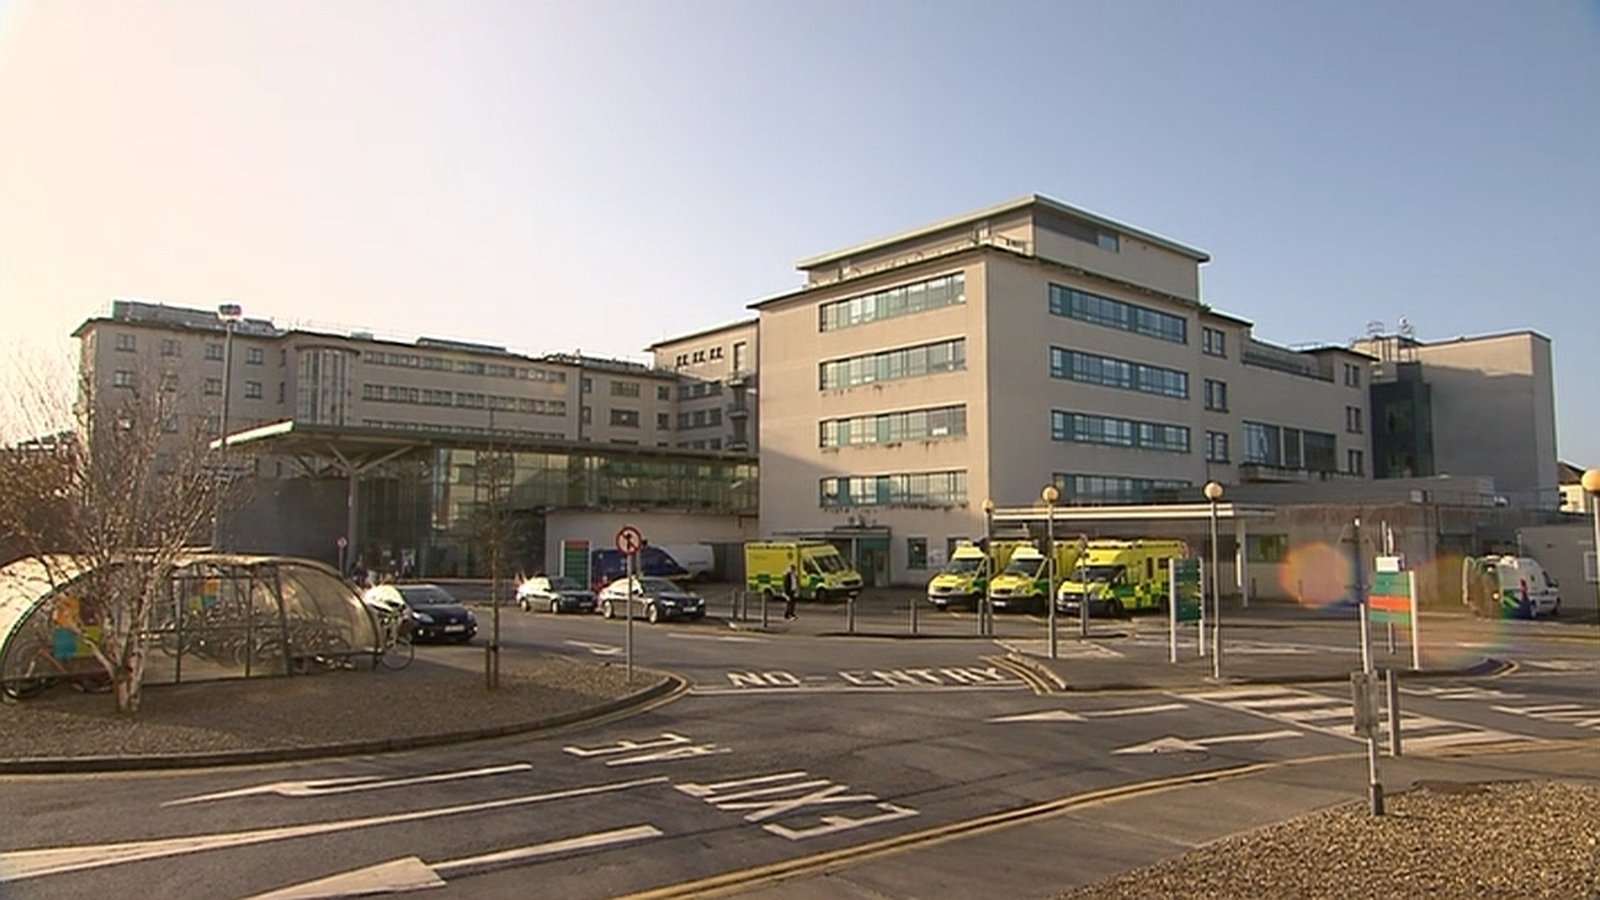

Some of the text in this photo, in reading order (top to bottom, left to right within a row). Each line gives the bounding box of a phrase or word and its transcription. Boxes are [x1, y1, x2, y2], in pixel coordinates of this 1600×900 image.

[726, 666, 1007, 688] NO ENTRY
[674, 771, 920, 841] EXIT
